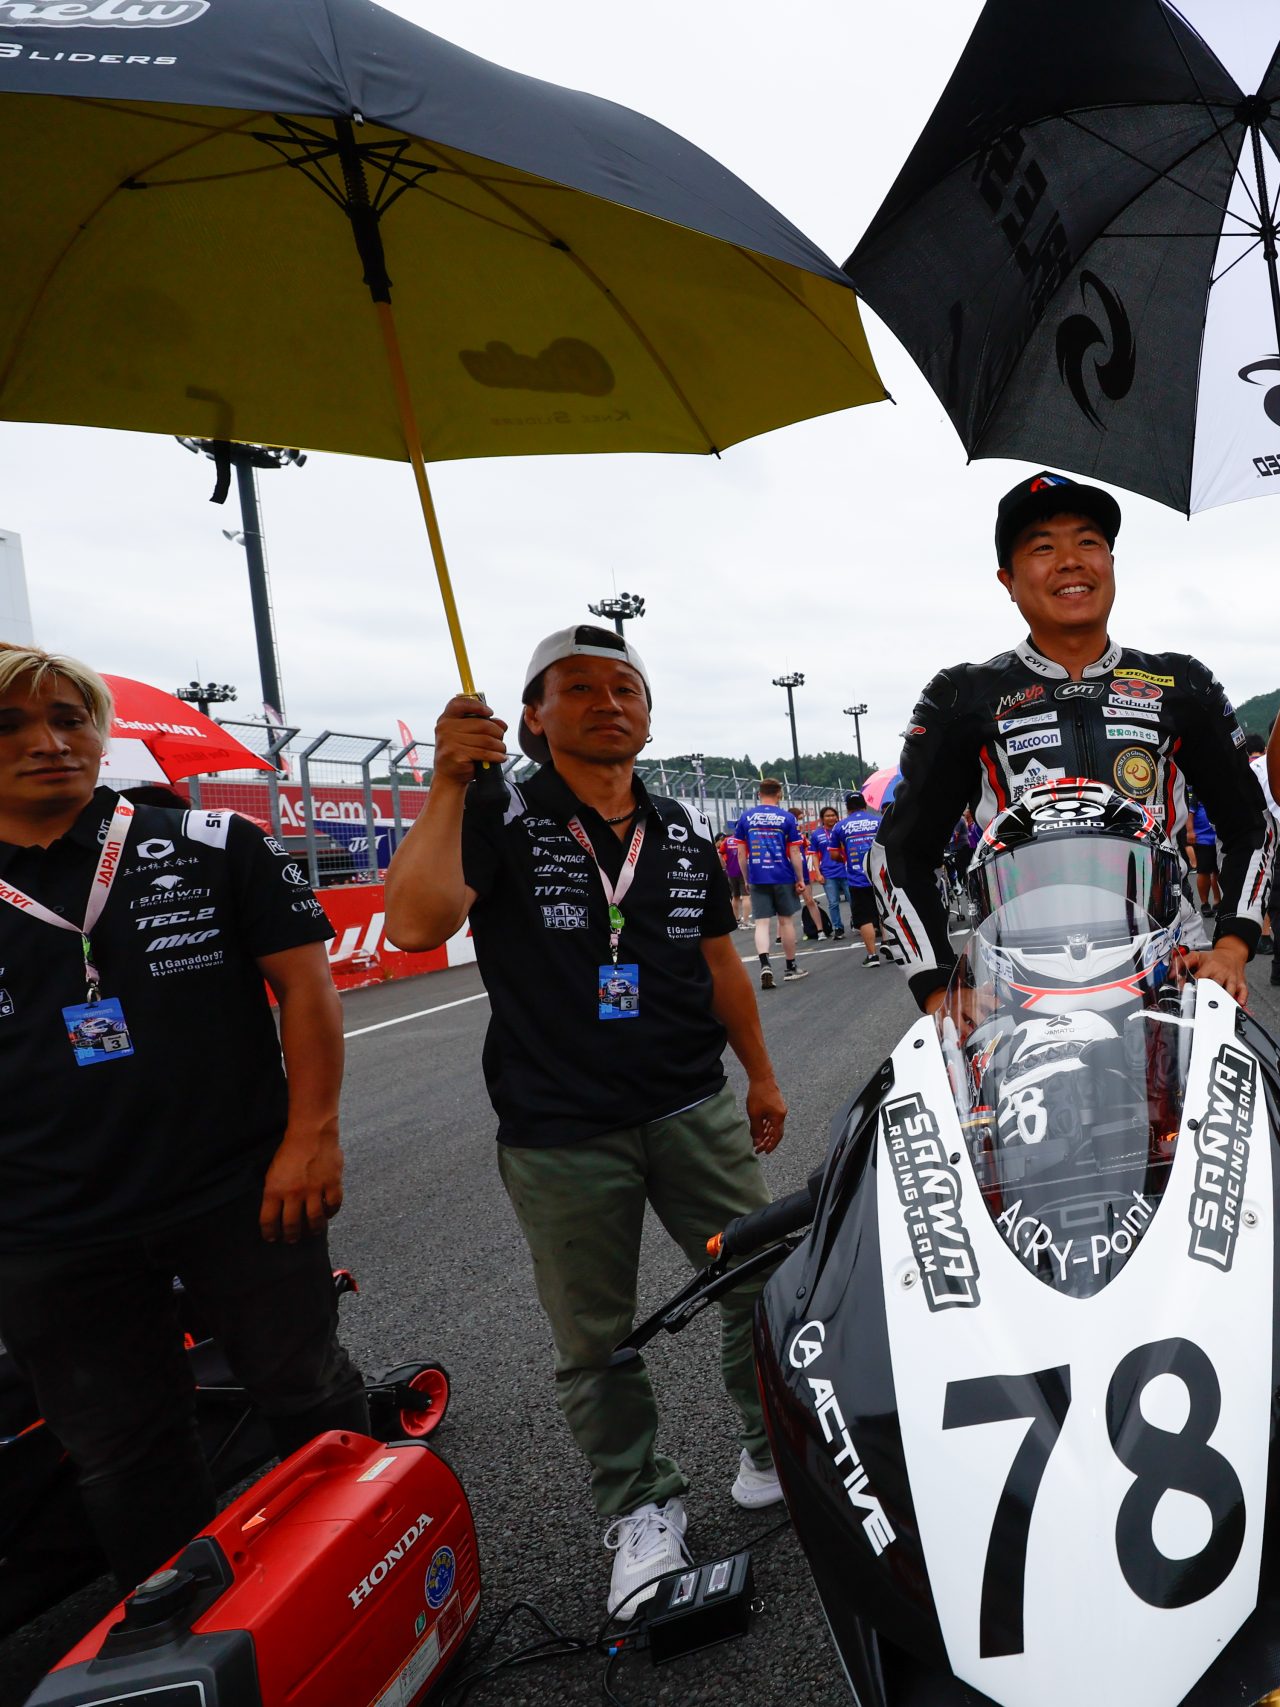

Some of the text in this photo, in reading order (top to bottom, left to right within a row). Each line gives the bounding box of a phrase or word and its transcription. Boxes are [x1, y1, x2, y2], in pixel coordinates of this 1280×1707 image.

[1125, 671, 1173, 683] DUNLOP
[278, 793, 382, 827] Astemo
[746, 812, 786, 821] VICTOR
[841, 819, 878, 831] VICTOR
[845, 826, 876, 835] RACING
[627, 828, 644, 867] JAPAN
[97, 841, 122, 888] JAPAN
[139, 888, 202, 904] SANWA
[135, 907, 216, 930] TEC.2
[543, 906, 586, 917] Baby
[546, 917, 586, 928] Face
[145, 929, 221, 953] MKP
[625, 1000, 632, 1009] 3
[112, 1039, 121, 1050] 3
[1194, 1061, 1238, 1231] SANWA
[1221, 1079, 1252, 1234] RACING TEAM
[888, 1124, 937, 1273] RACING TEAM
[903, 1113, 974, 1277] SANWA
[807, 1377, 897, 1557] ACTIVE
[941, 1336, 1246, 1659] 78
[347, 1513, 434, 1610] HONDA
